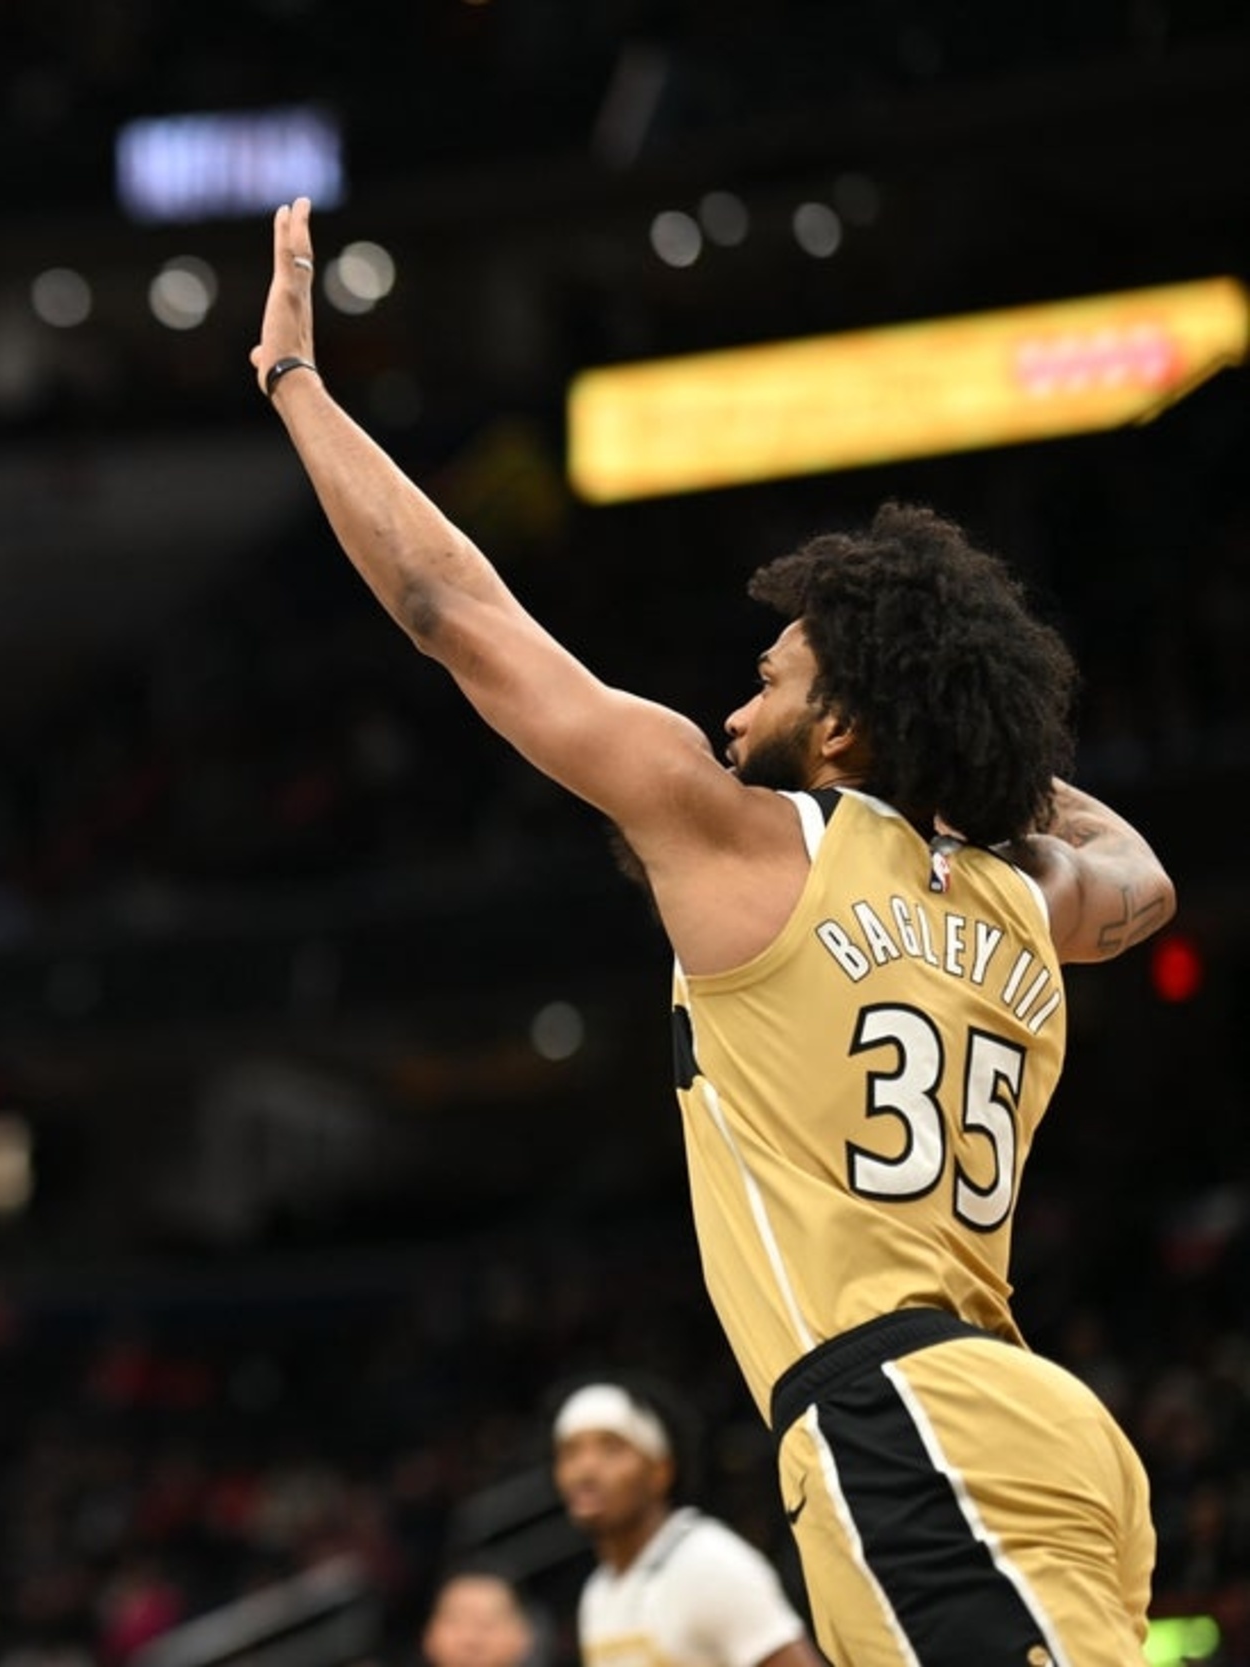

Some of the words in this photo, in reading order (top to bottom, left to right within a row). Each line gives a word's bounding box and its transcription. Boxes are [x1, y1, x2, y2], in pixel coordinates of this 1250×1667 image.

[815, 895, 1005, 987] BAGLEY
[1002, 948, 1062, 1035] III
[845, 1002, 1027, 1234] 35
